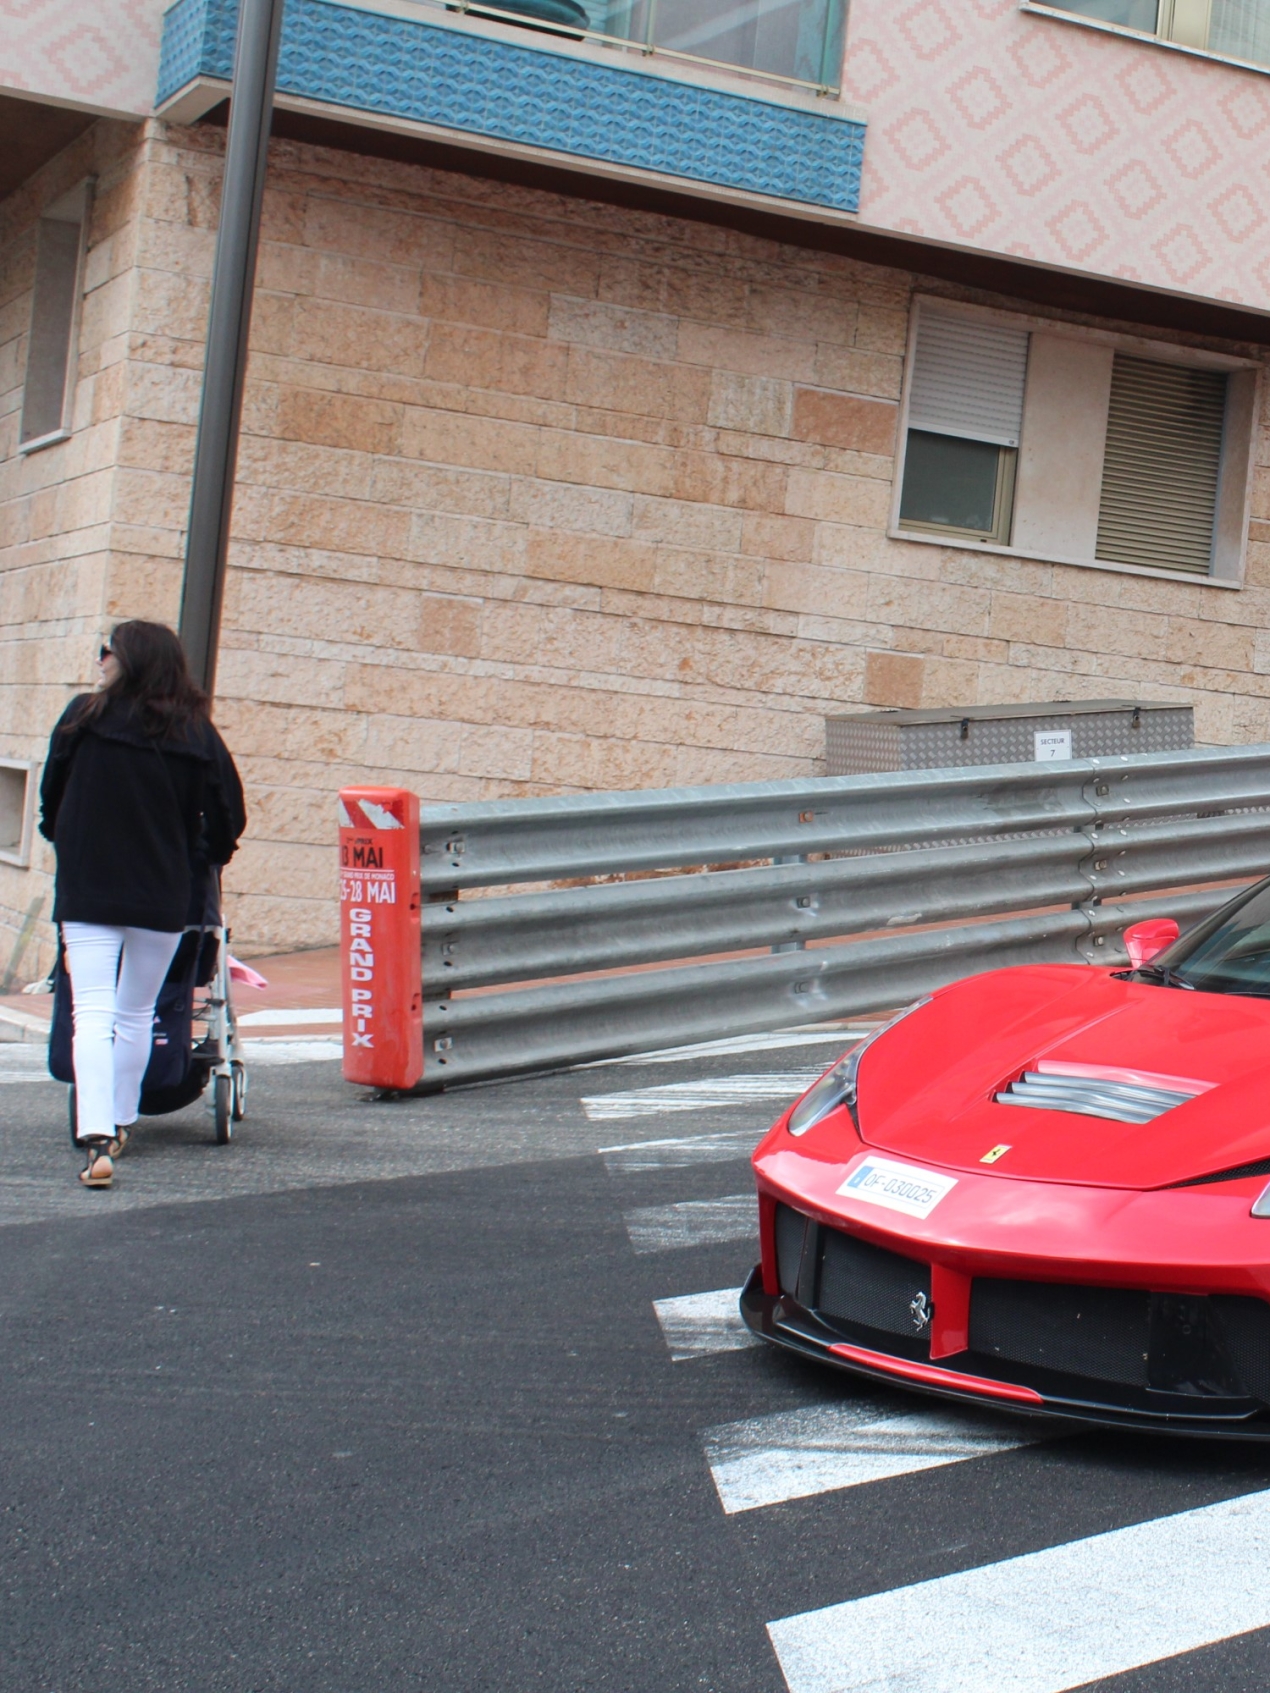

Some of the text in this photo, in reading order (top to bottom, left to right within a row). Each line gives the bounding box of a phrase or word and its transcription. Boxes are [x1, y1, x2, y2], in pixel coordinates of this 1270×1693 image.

[1040, 738, 1065, 746] SECTEUR
[1050, 749, 1056, 757] 7
[353, 847, 384, 869] MAI
[367, 881, 396, 904] MAI
[349, 907, 375, 1049] GRAND PRIX
